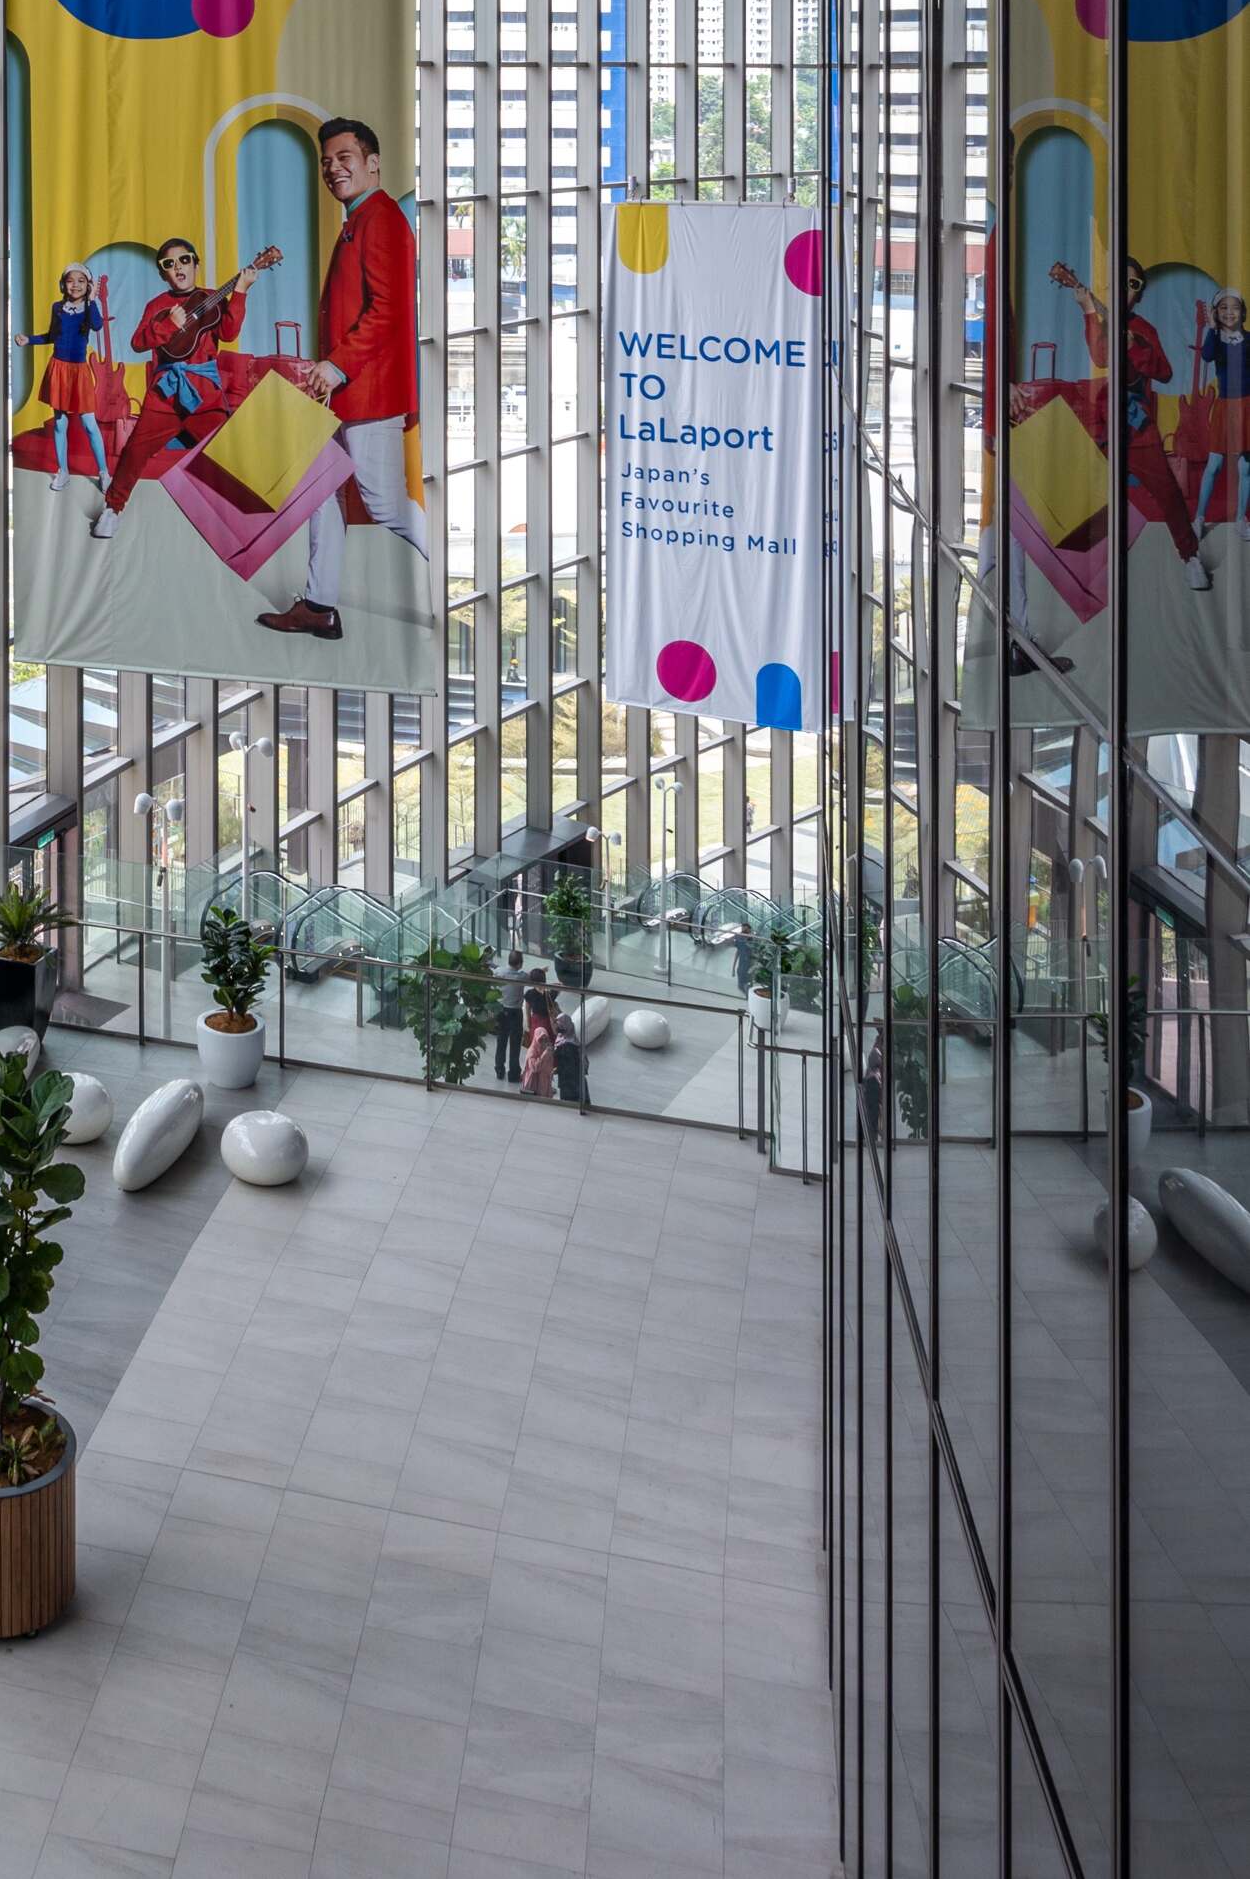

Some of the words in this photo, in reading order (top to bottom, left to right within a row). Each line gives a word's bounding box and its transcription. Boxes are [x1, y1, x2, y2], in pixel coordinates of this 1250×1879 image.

[617, 330, 807, 369] WELCOME
[618, 371, 667, 402] TO
[618, 413, 774, 454] LaLaport
[620, 463, 711, 486] Japan's
[620, 492, 735, 519] Favourite
[620, 521, 737, 553] Shopping
[745, 535, 798, 556] Mall
